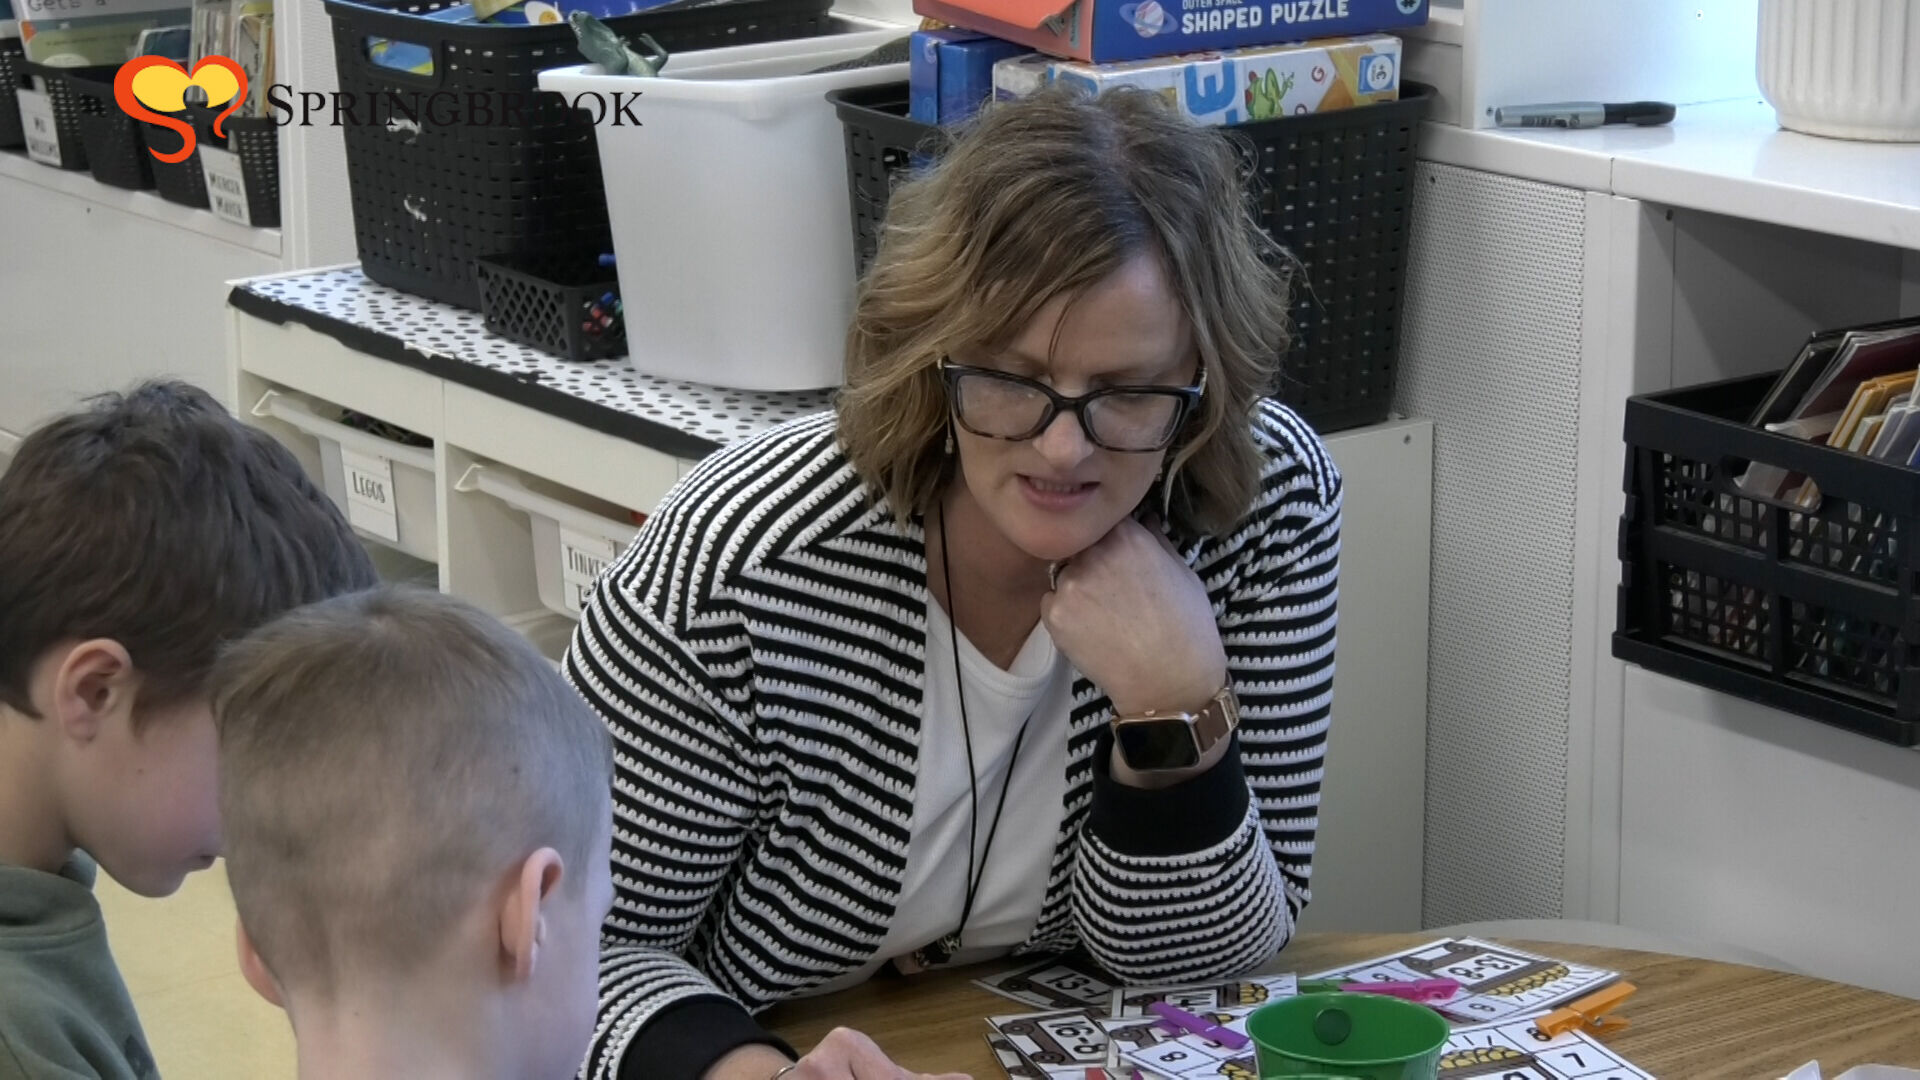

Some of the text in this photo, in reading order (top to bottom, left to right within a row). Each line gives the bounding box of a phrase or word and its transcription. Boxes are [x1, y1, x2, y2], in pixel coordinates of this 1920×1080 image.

[1182, 0, 1349, 34] SHAPED PUZZLE
[352, 471, 386, 504] LEGOS
